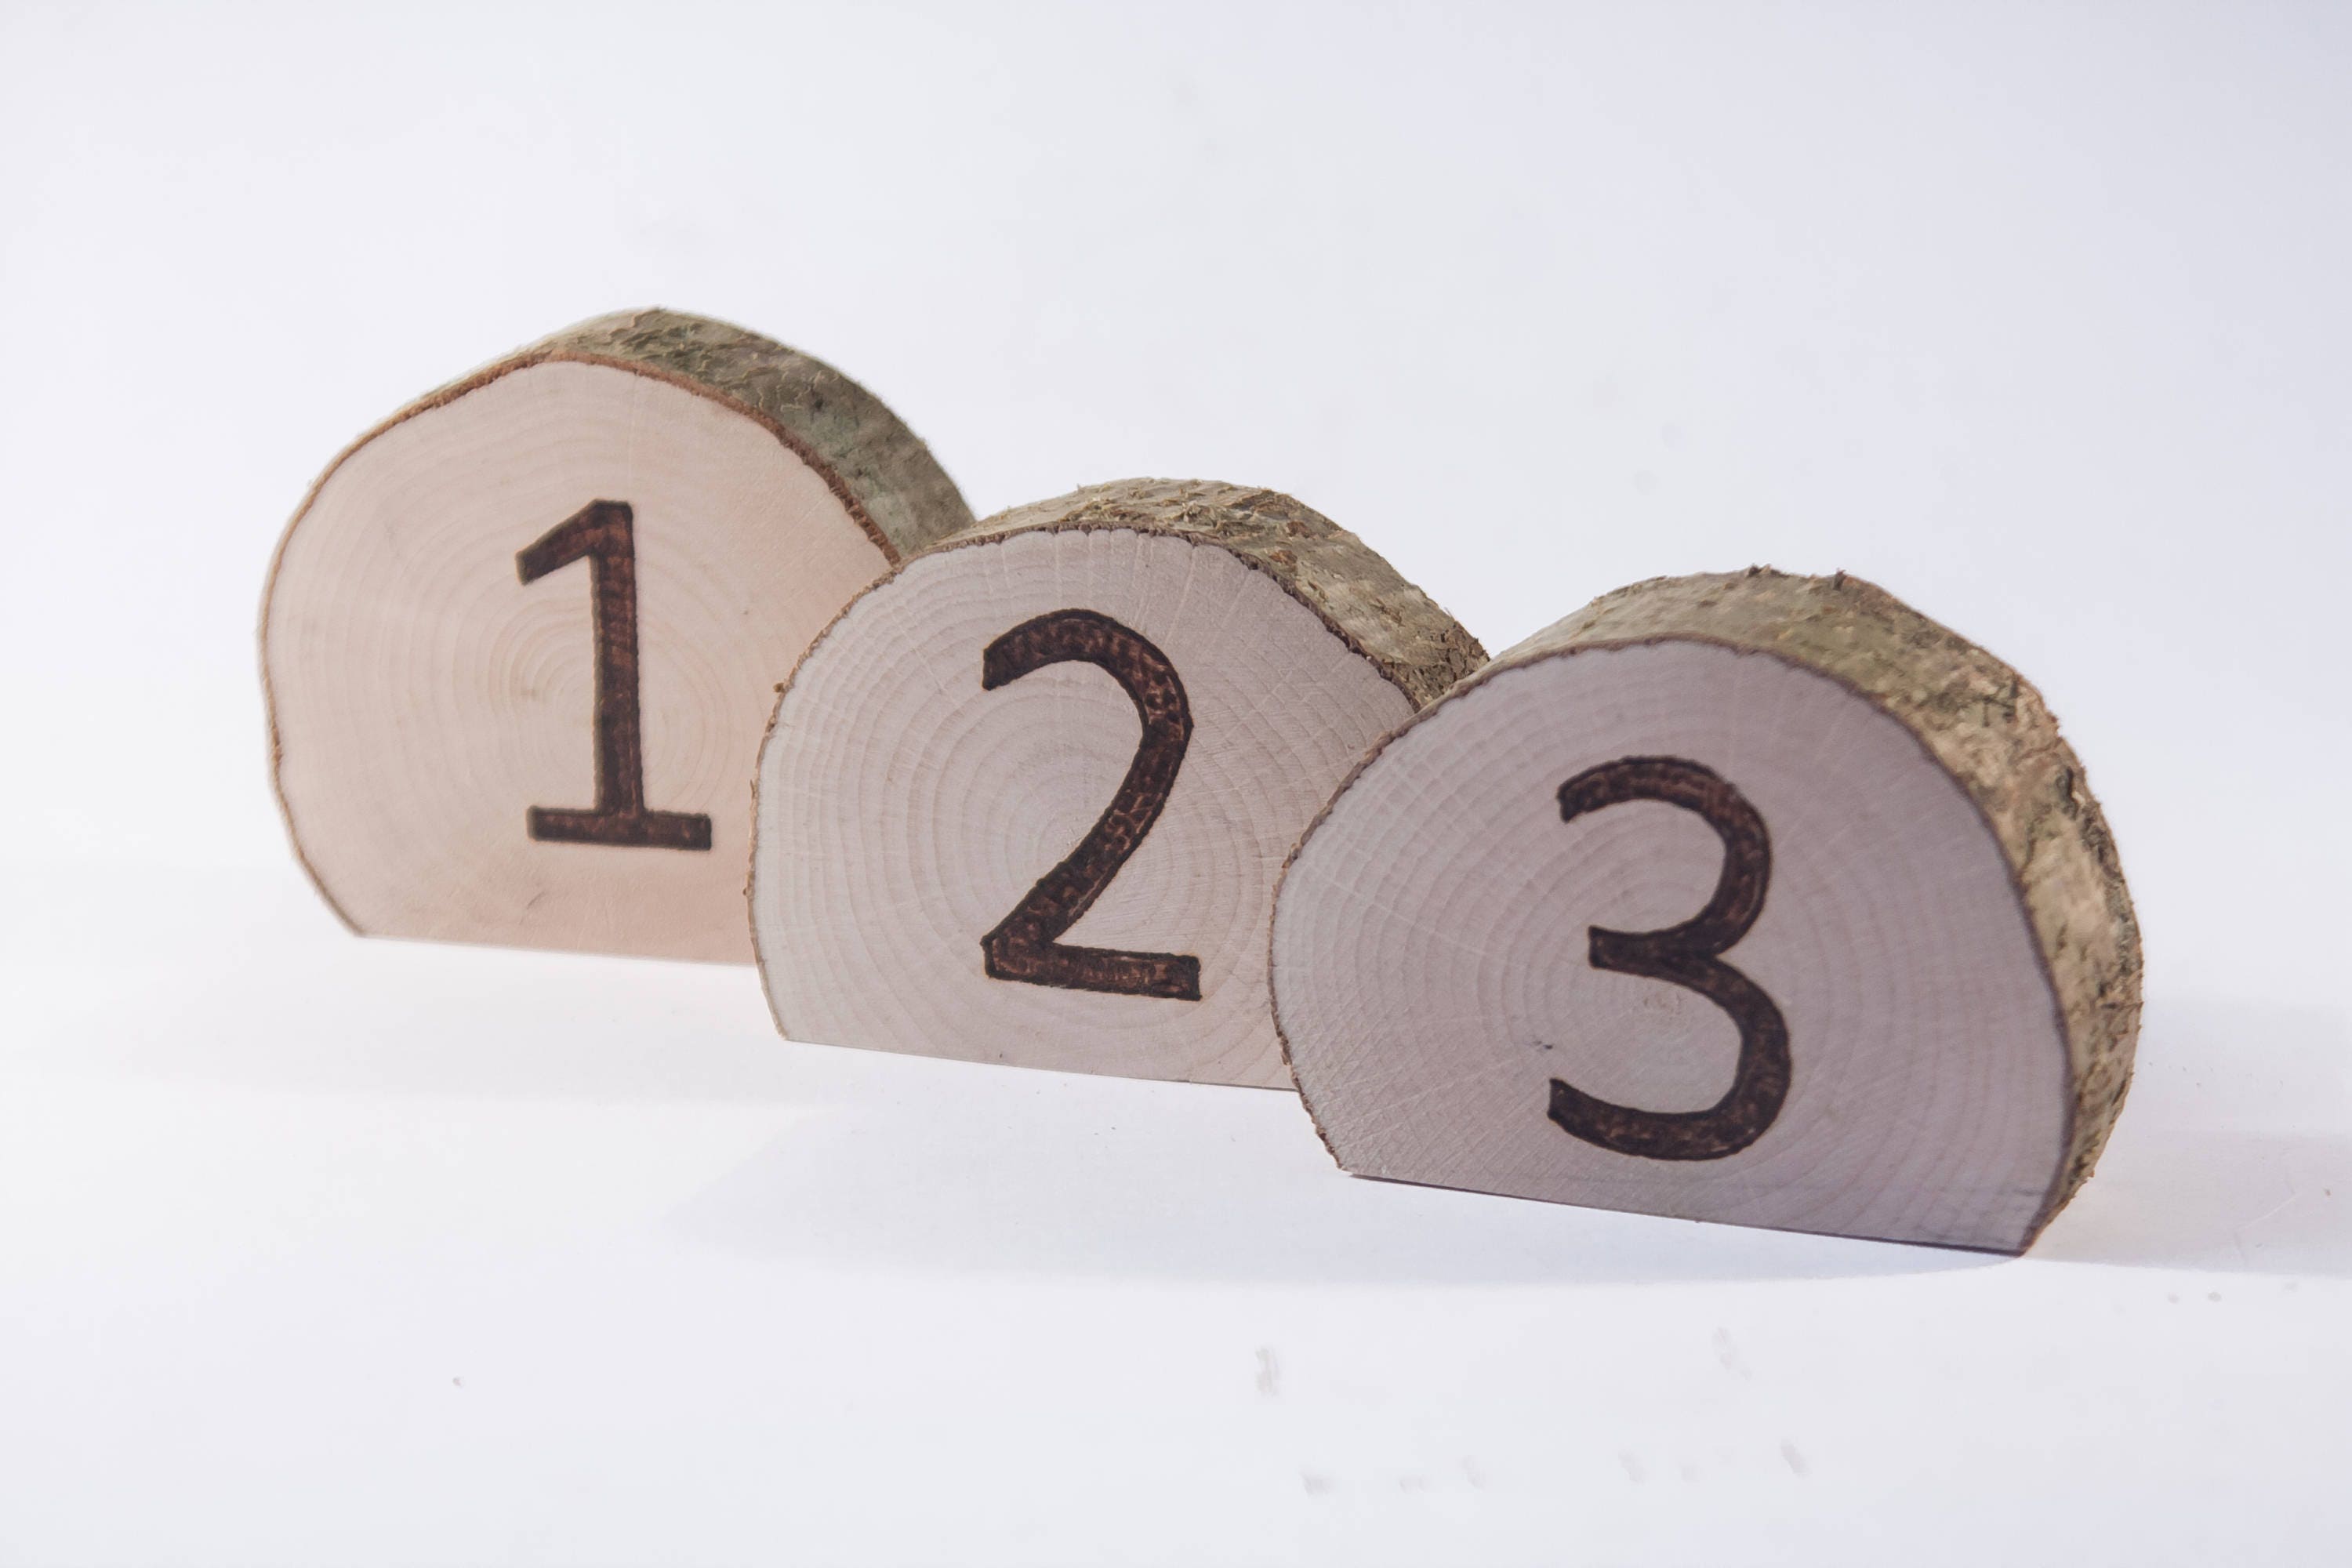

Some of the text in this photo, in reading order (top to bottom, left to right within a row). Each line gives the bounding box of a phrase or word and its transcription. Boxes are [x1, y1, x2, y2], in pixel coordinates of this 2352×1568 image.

[517, 499, 713, 851] 1
[979, 607, 1203, 1002] 2
[1545, 753, 1795, 1163] 3
